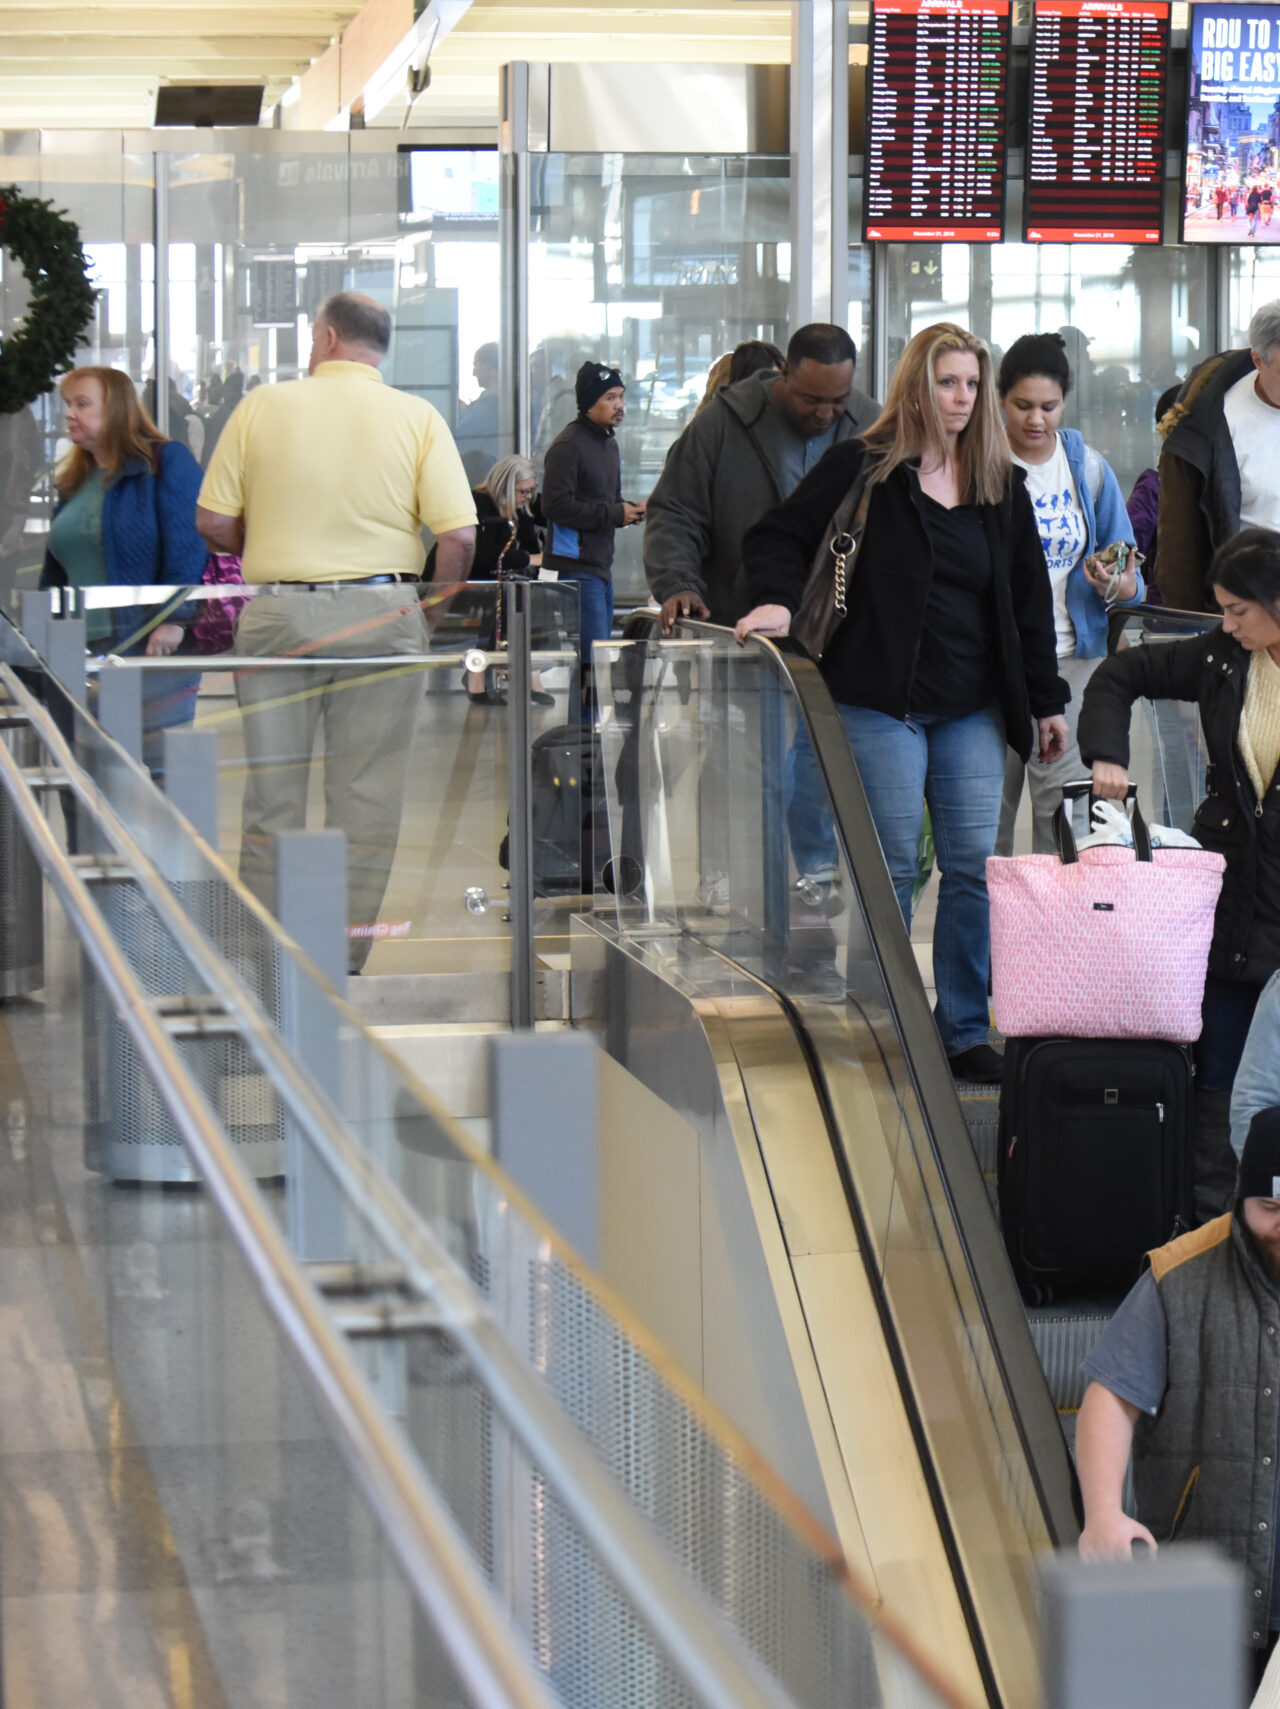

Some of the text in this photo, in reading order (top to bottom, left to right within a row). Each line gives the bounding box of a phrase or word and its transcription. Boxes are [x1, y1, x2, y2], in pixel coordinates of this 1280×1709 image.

[1081, 3, 1123, 11] ARRIVALS
[1202, 18, 1242, 49] RDU
[1246, 19, 1271, 49] TO
[1200, 50, 1234, 82] BIG
[1047, 557, 1073, 569] ORTS
